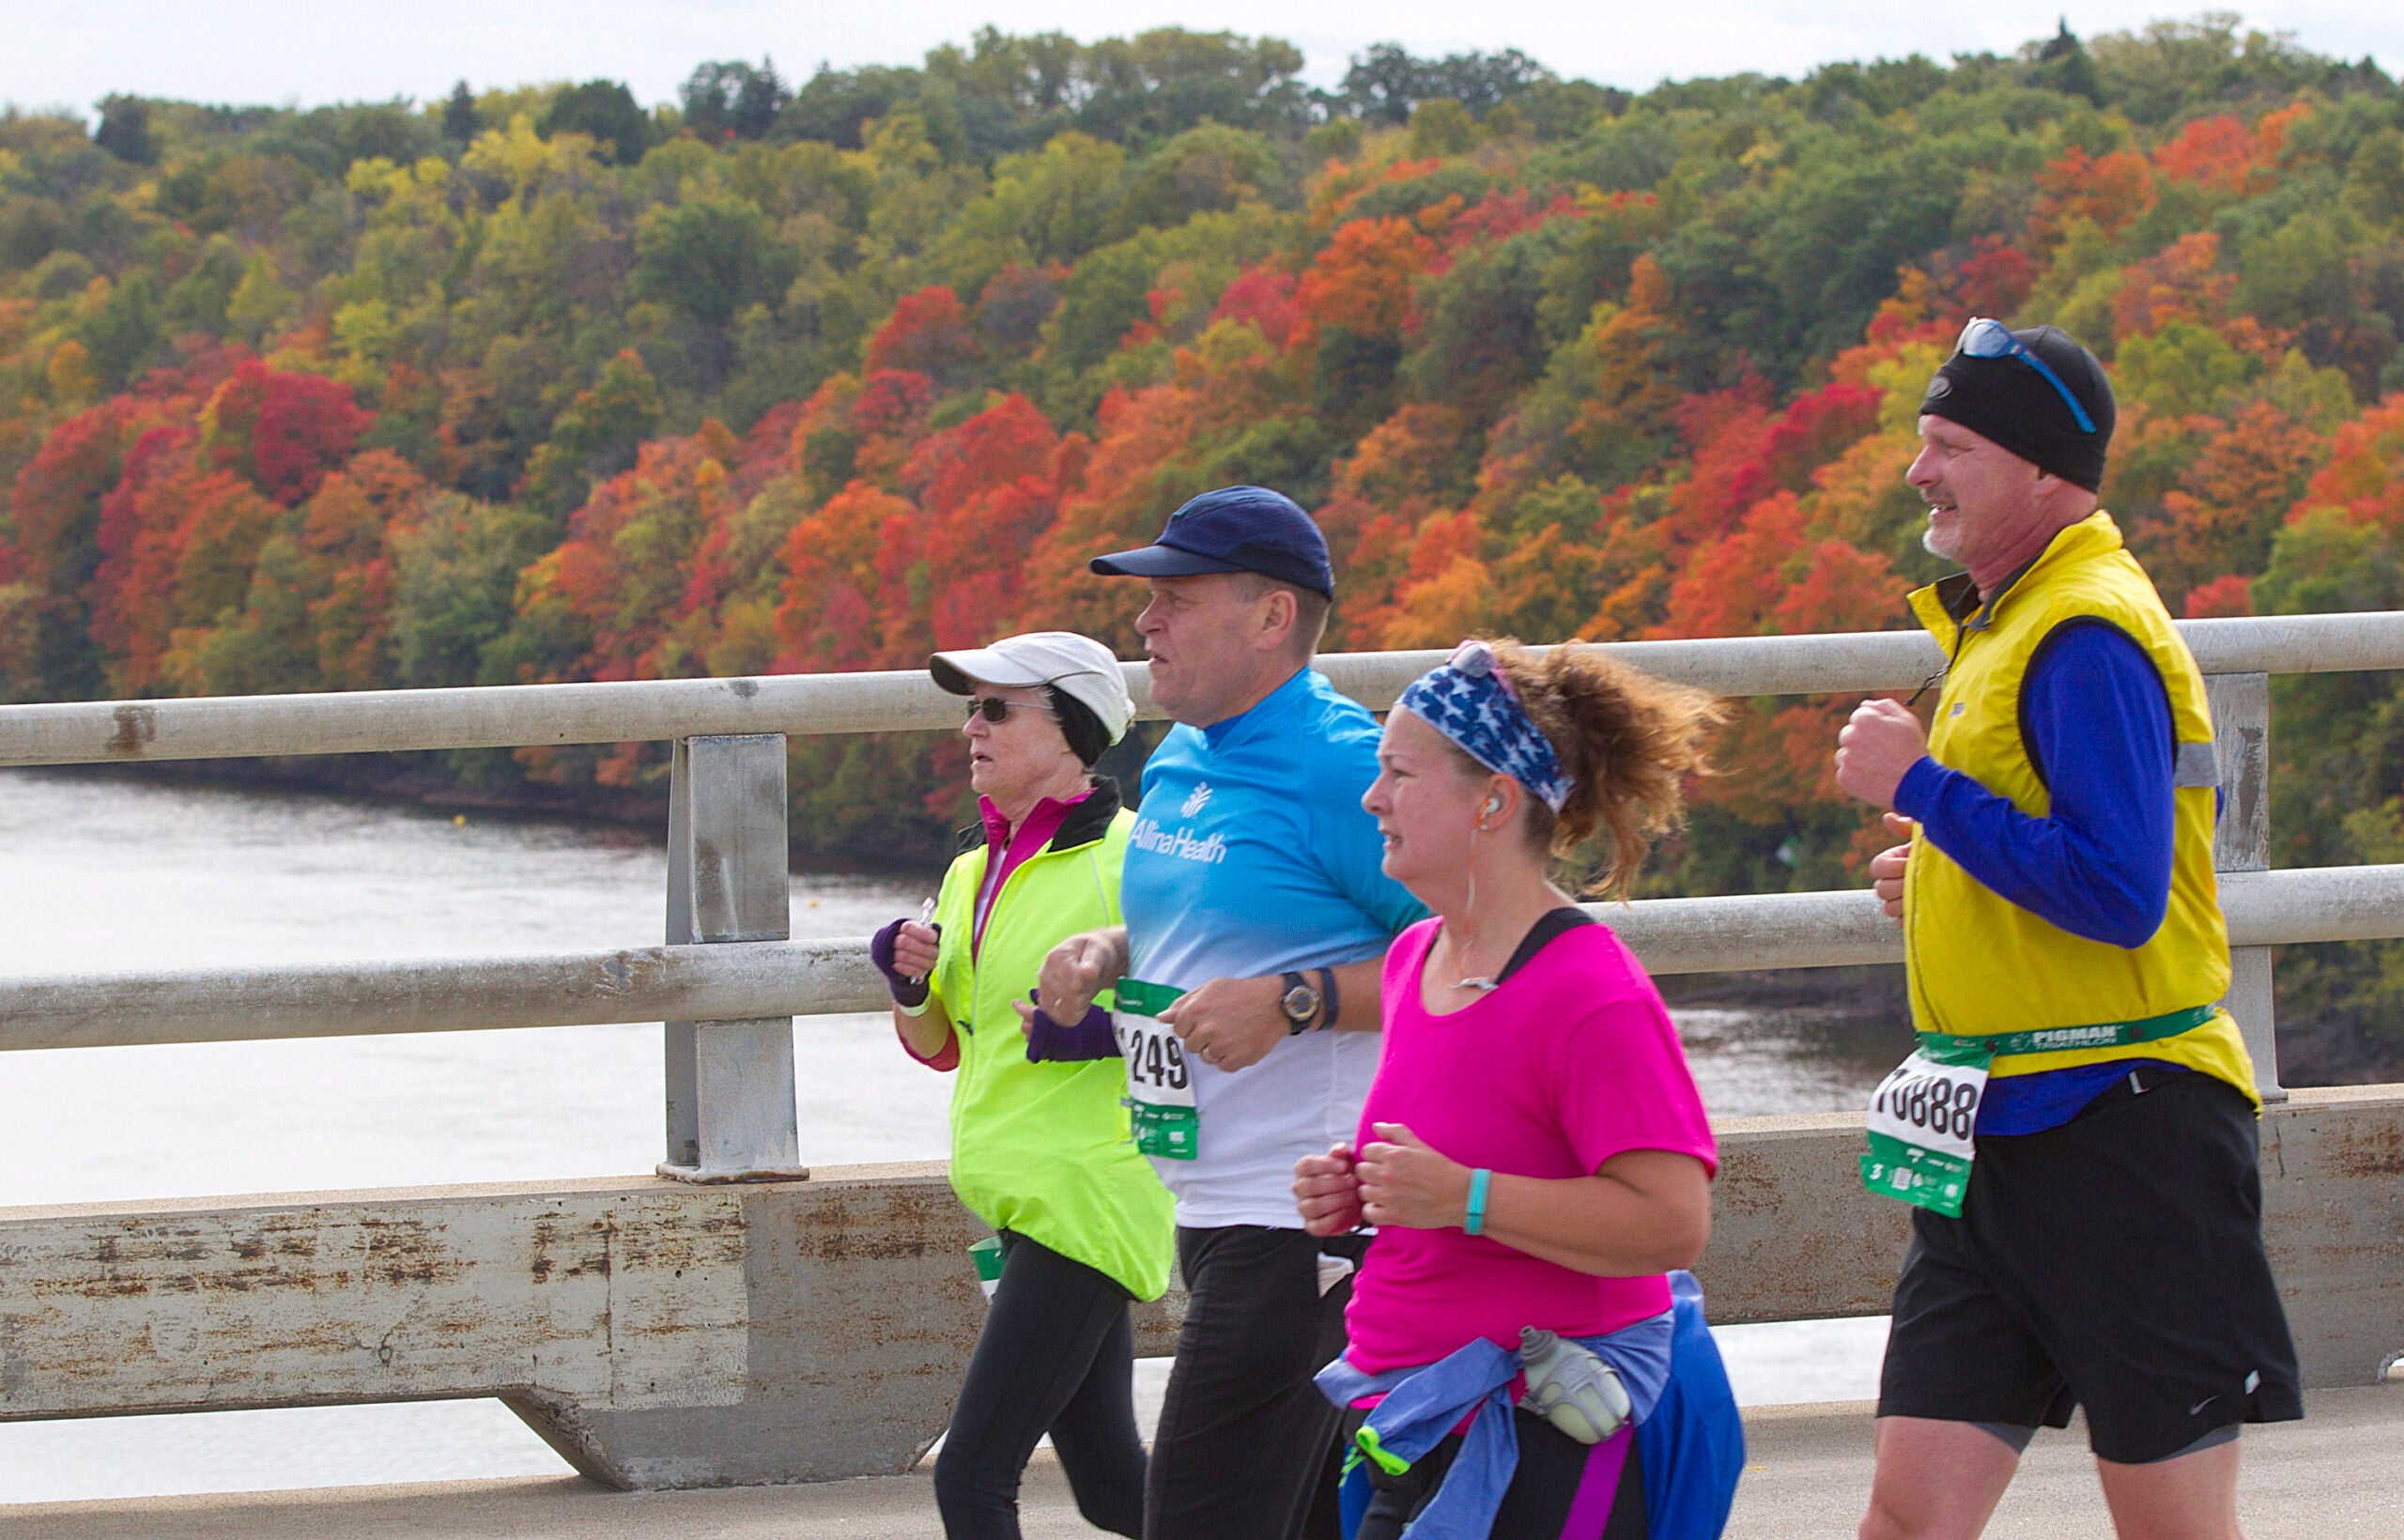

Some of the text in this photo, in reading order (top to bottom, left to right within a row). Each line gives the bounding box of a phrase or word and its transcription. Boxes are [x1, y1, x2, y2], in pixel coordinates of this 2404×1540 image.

[1128, 818, 1227, 864] Allina Health
[2032, 1024, 2118, 1044] PIGMAN
